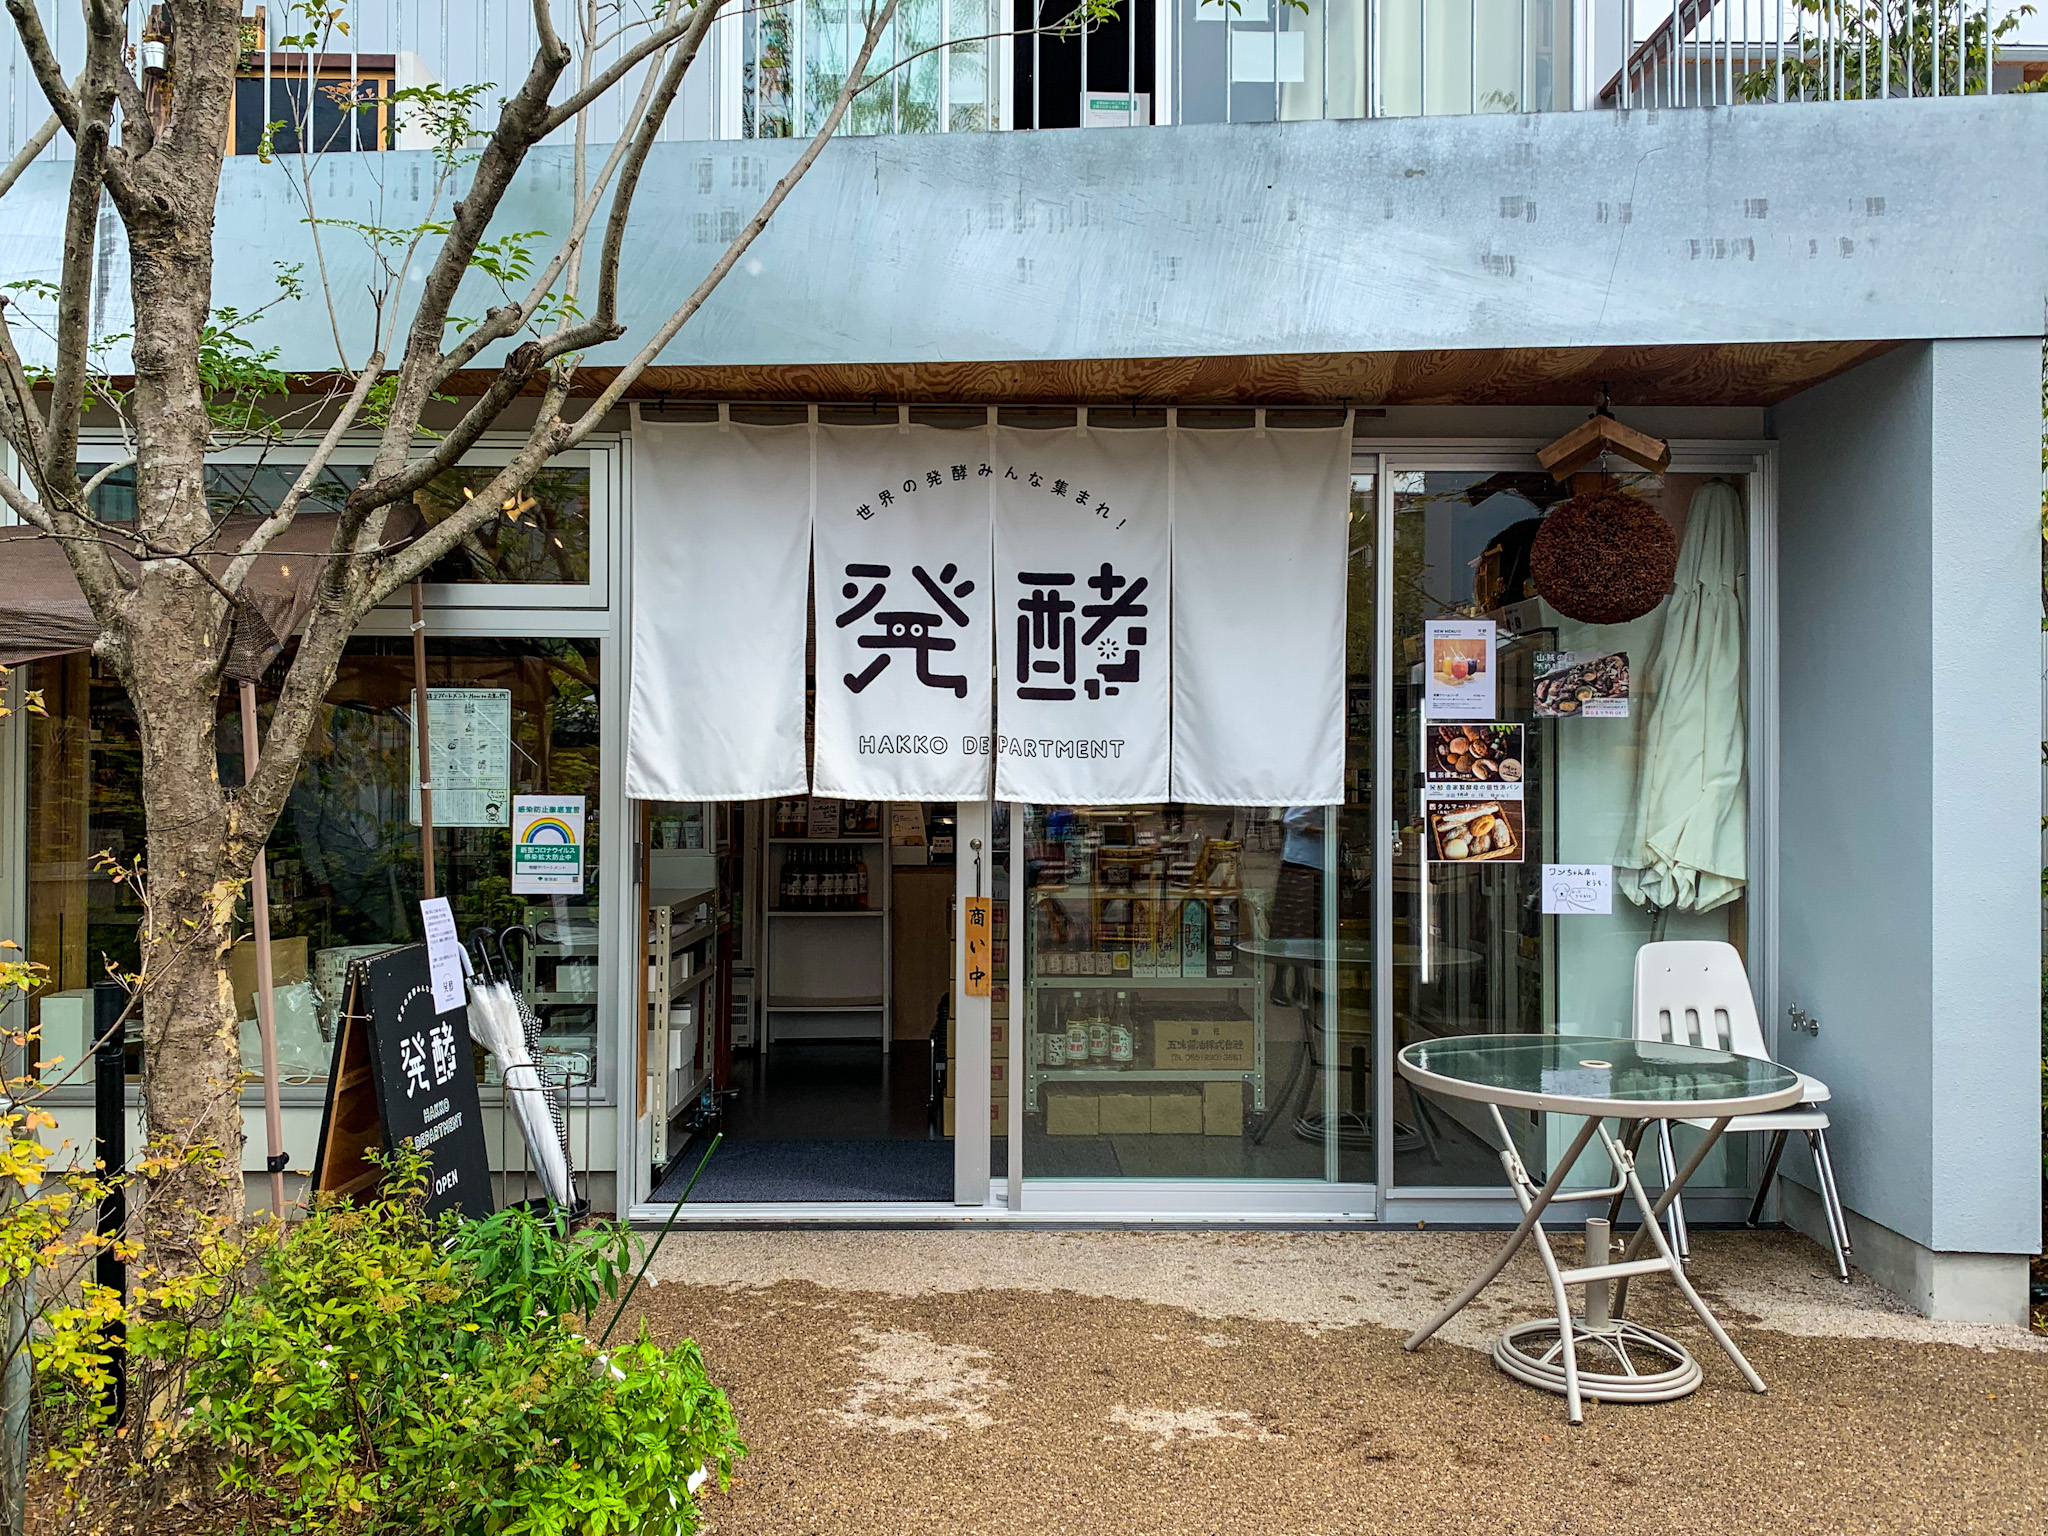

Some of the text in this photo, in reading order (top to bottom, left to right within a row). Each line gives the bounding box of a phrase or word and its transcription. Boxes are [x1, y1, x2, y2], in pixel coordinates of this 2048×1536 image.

[836, 563, 1148, 701] 発酵
[859, 735, 1125, 758] HAKKO DEPARTMENT
[518, 806, 580, 814] 感染防止徹底宣言
[969, 906, 986, 988] 商い中
[400, 1021, 457, 1099] 発酵
[423, 1098, 450, 1124] HAKKO
[414, 1112, 462, 1152] DEPARTMENT
[435, 1169, 459, 1196] OPEN
